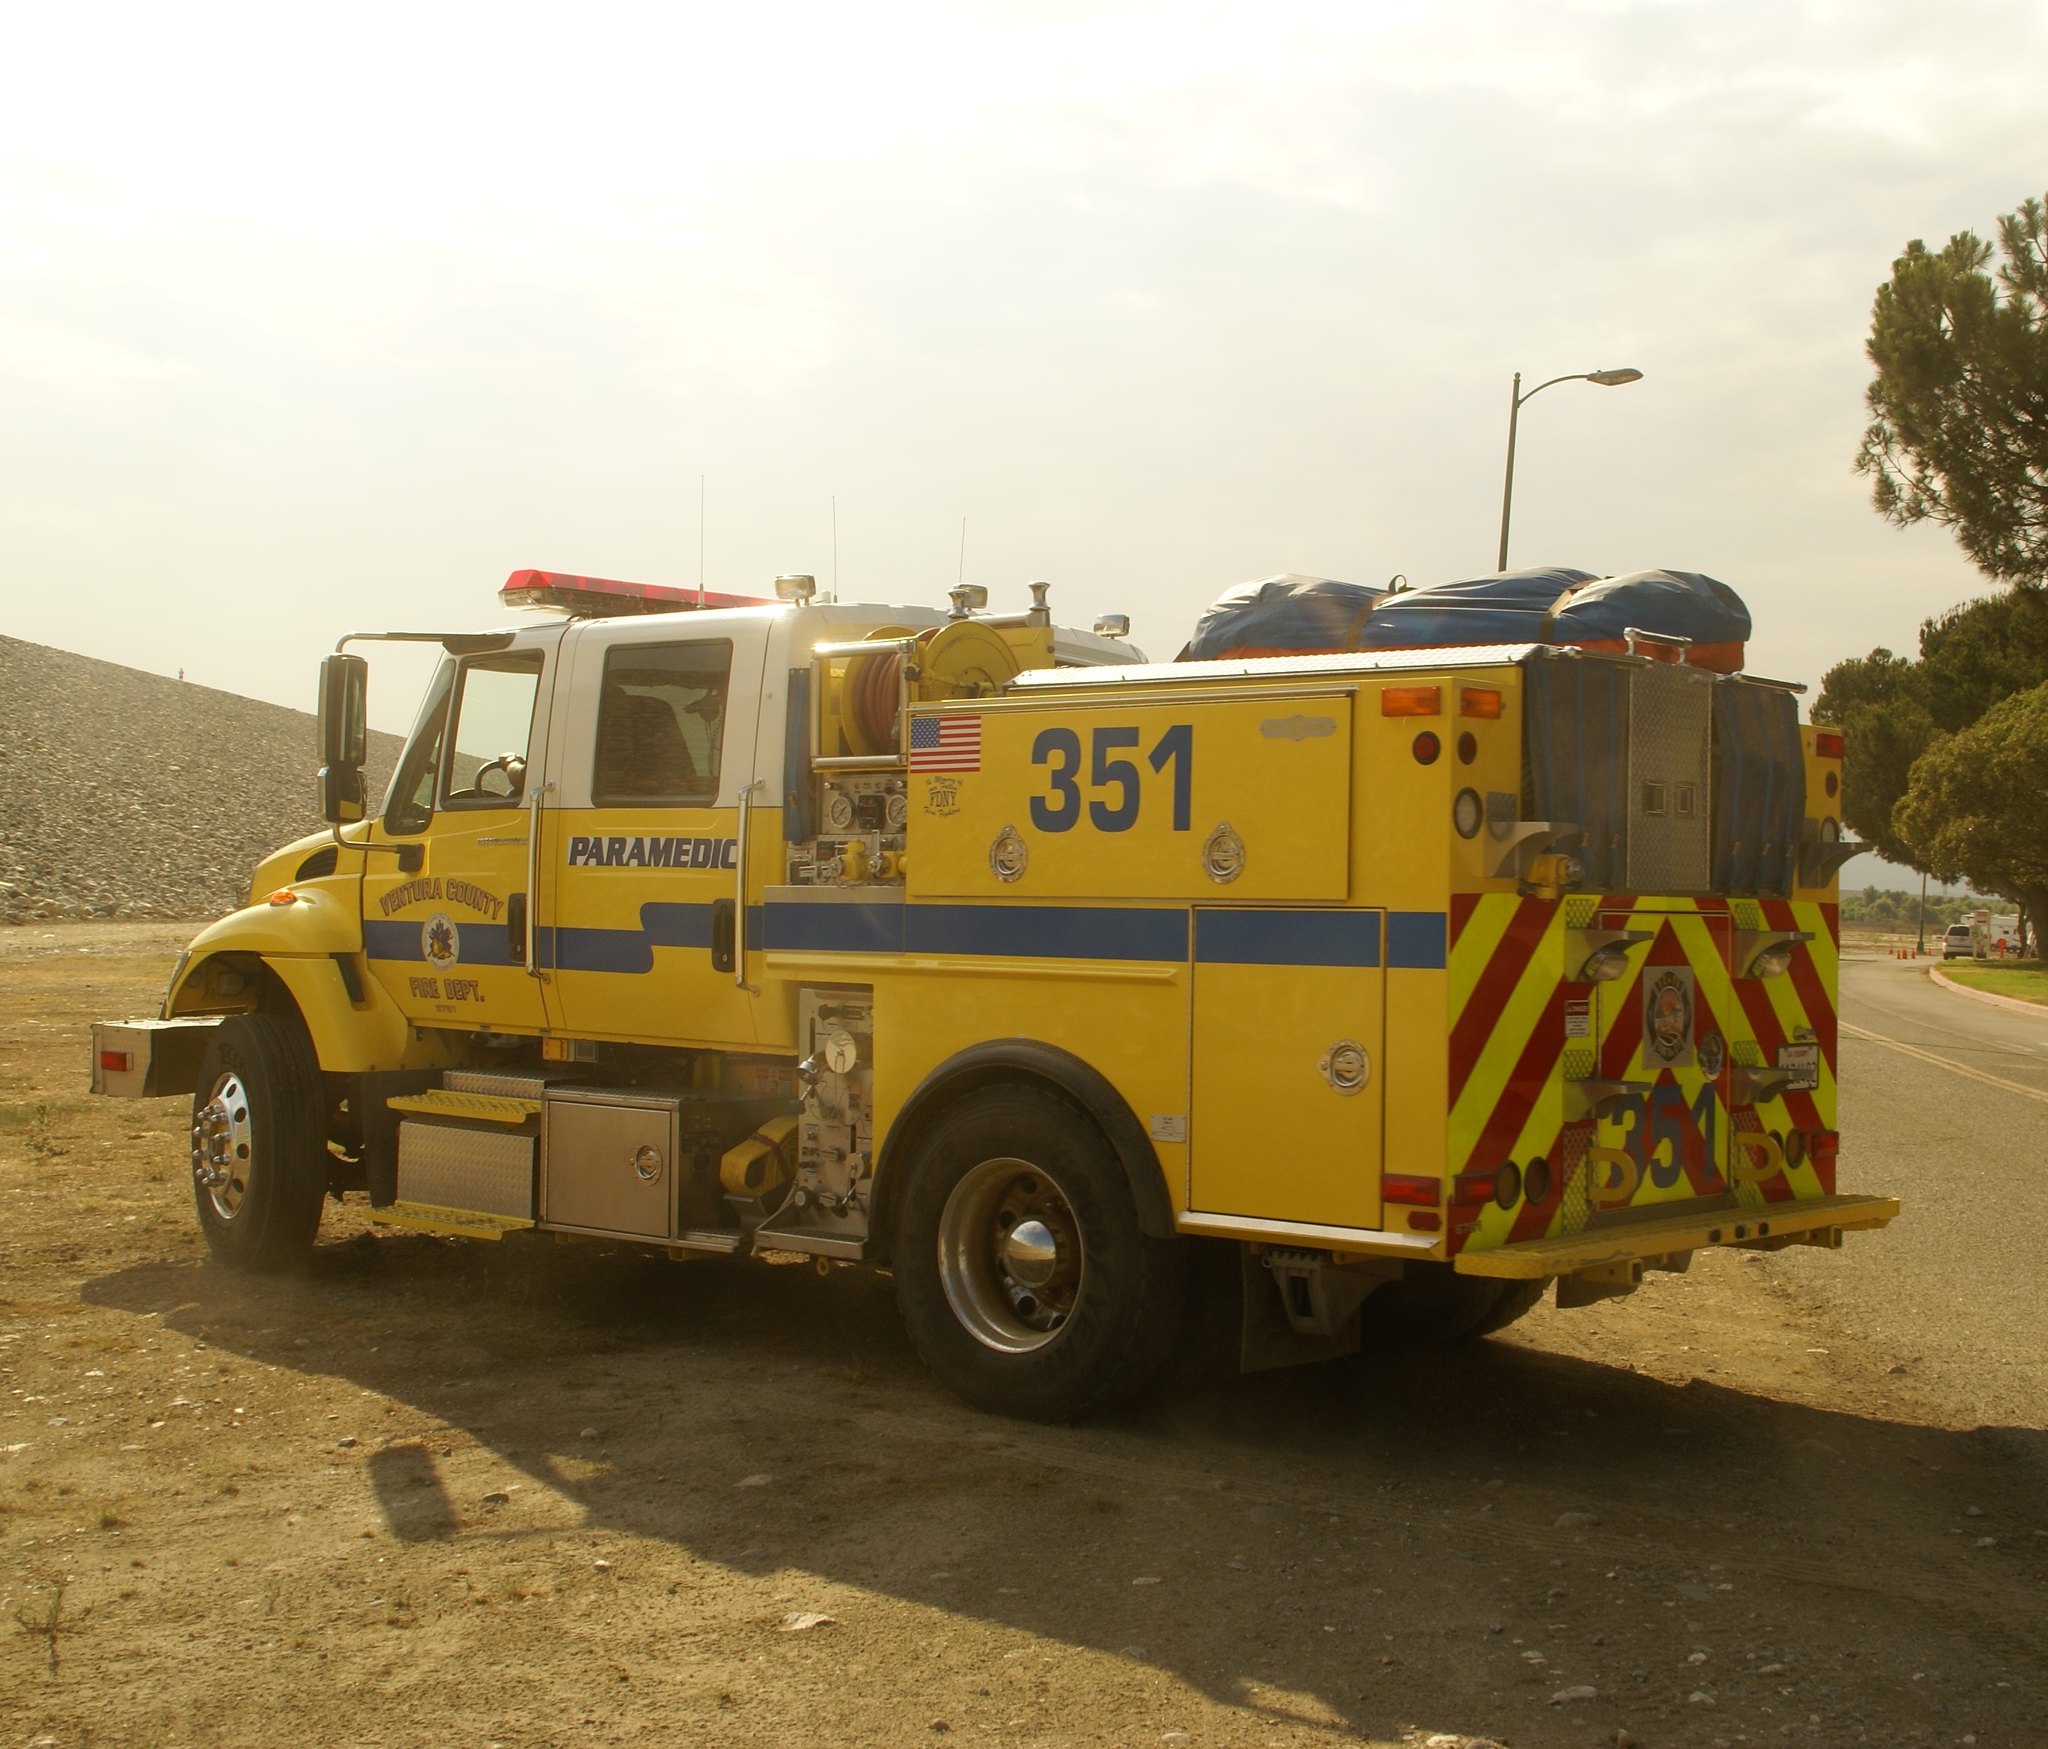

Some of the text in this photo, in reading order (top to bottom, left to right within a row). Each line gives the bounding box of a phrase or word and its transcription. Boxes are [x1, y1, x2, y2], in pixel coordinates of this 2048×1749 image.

[1029, 724, 1194, 834] 351
[930, 790, 957, 807] FDNY
[568, 836, 737, 869] PARAMEDIC
[379, 877, 504, 921] VENTURA COUNTY
[409, 976, 486, 1002] FIRE DEPT.
[1610, 1082, 1716, 1191] 351
